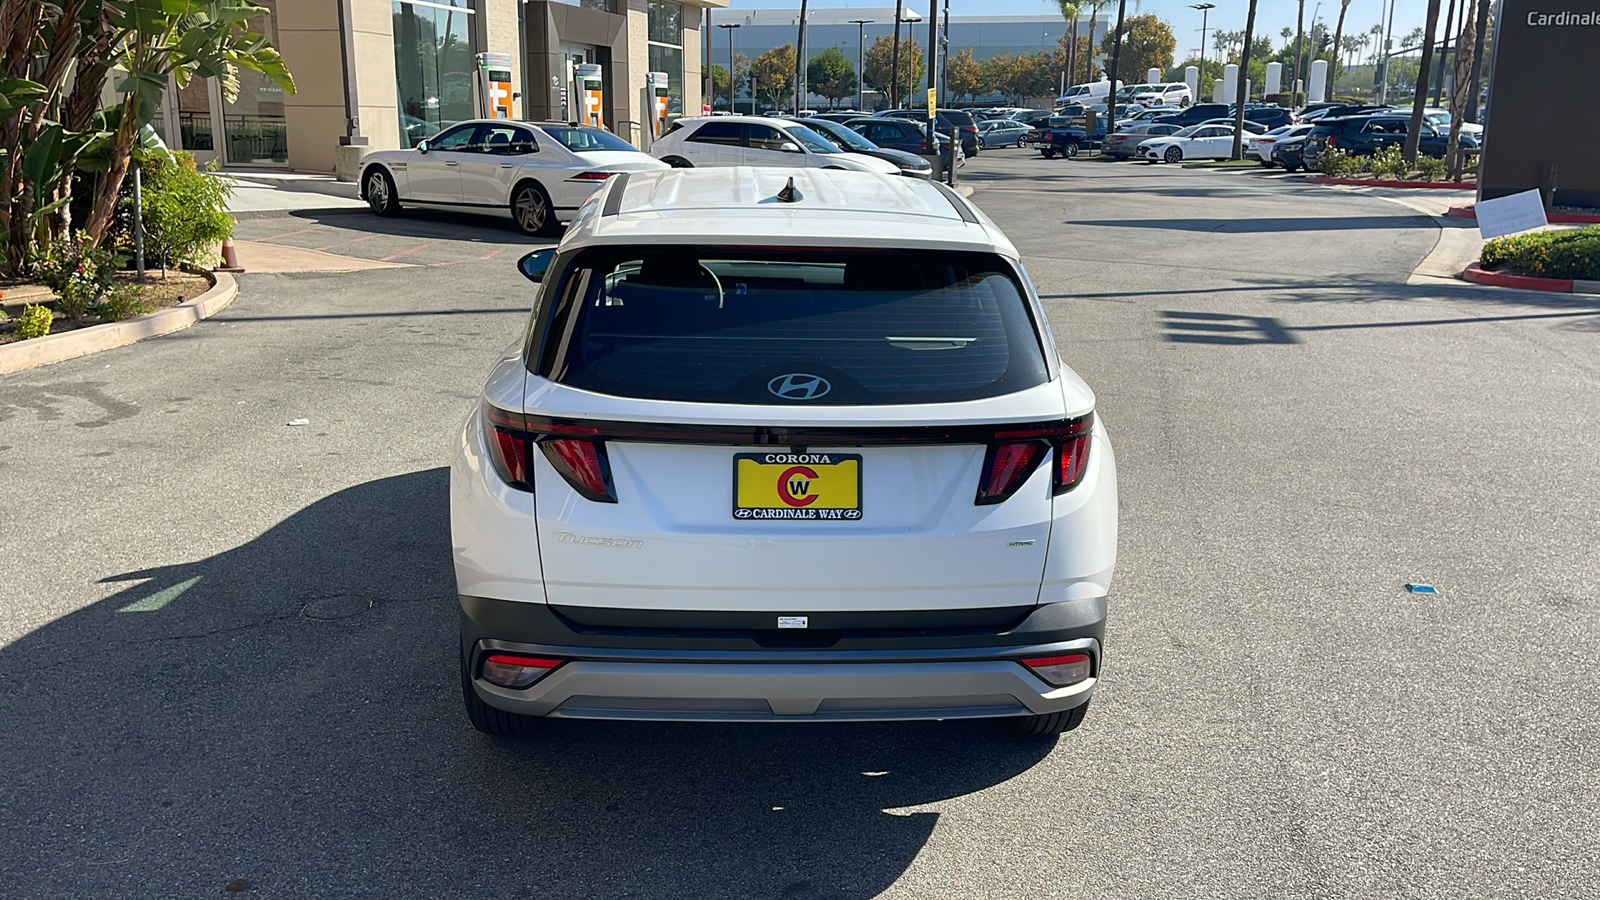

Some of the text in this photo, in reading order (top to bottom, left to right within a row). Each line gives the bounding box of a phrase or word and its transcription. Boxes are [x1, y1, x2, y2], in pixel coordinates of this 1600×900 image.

[765, 454, 831, 464] CORONA
[753, 509, 843, 519] CARDINALE WAY
